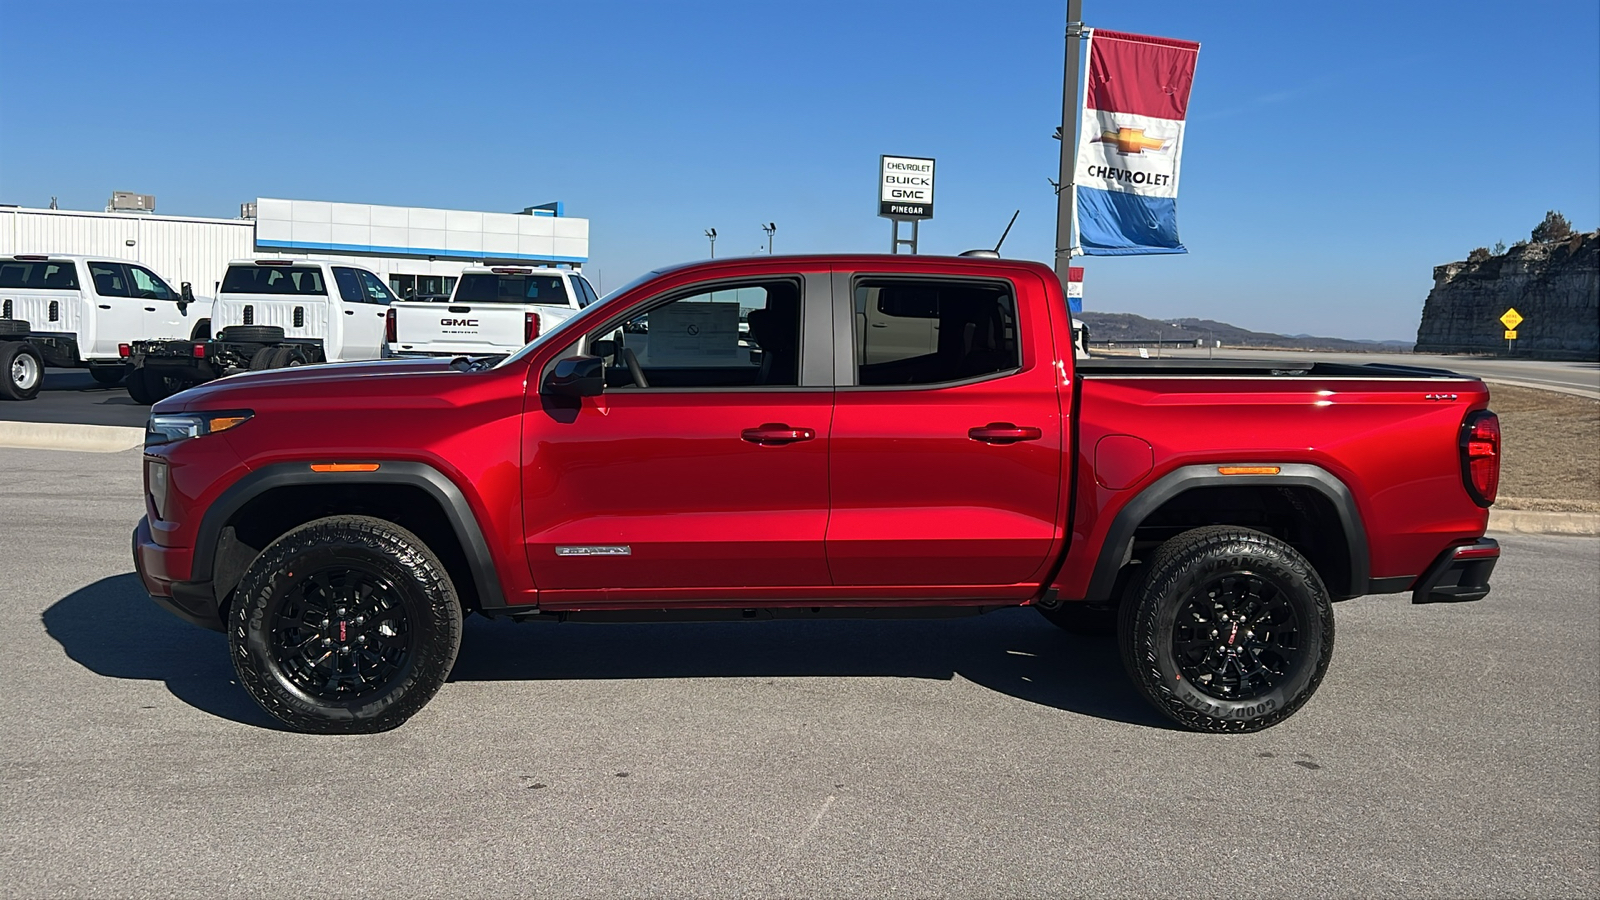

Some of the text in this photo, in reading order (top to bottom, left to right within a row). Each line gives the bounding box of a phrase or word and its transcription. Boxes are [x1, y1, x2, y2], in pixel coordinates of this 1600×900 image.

[887, 162, 931, 172] CHEVROLET
[886, 175, 930, 186] BUICK
[1088, 165, 1169, 186] CHEVROLET
[891, 189, 924, 199] GMC
[891, 205, 923, 214] PINEGAR
[441, 318, 479, 327] GMC
